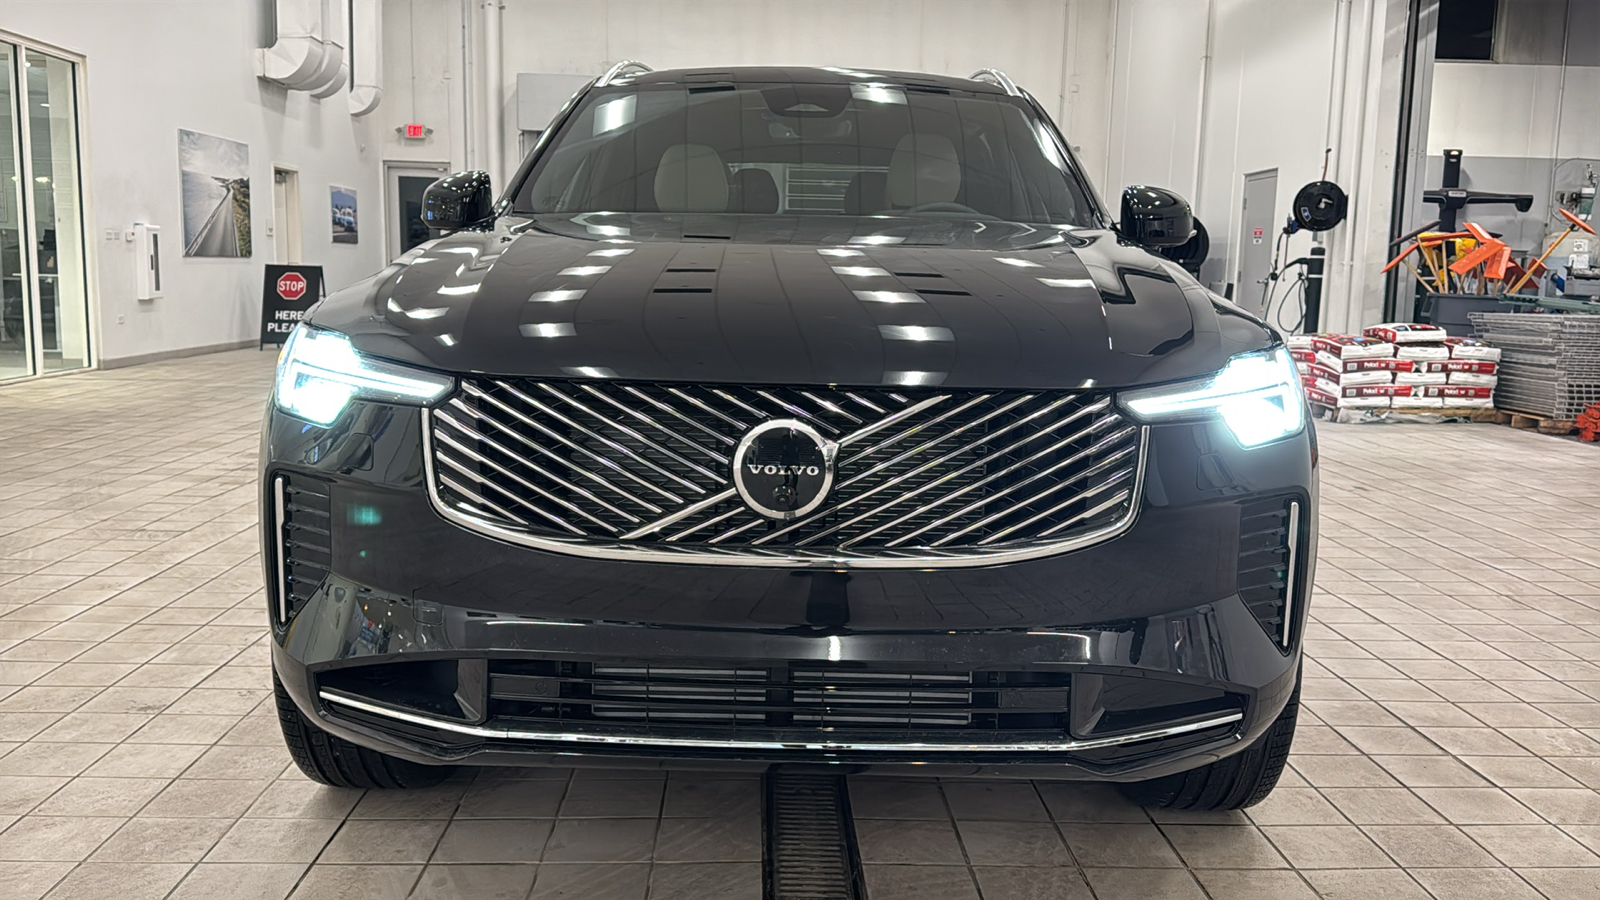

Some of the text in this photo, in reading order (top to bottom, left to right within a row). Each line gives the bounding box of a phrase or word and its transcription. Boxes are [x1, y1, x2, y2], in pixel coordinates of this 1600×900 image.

[407, 124, 422, 137] EXIT
[279, 281, 304, 291] STOP
[275, 310, 304, 320] HERE
[267, 322, 296, 333] PLEA
[748, 464, 819, 476] VOLVO
